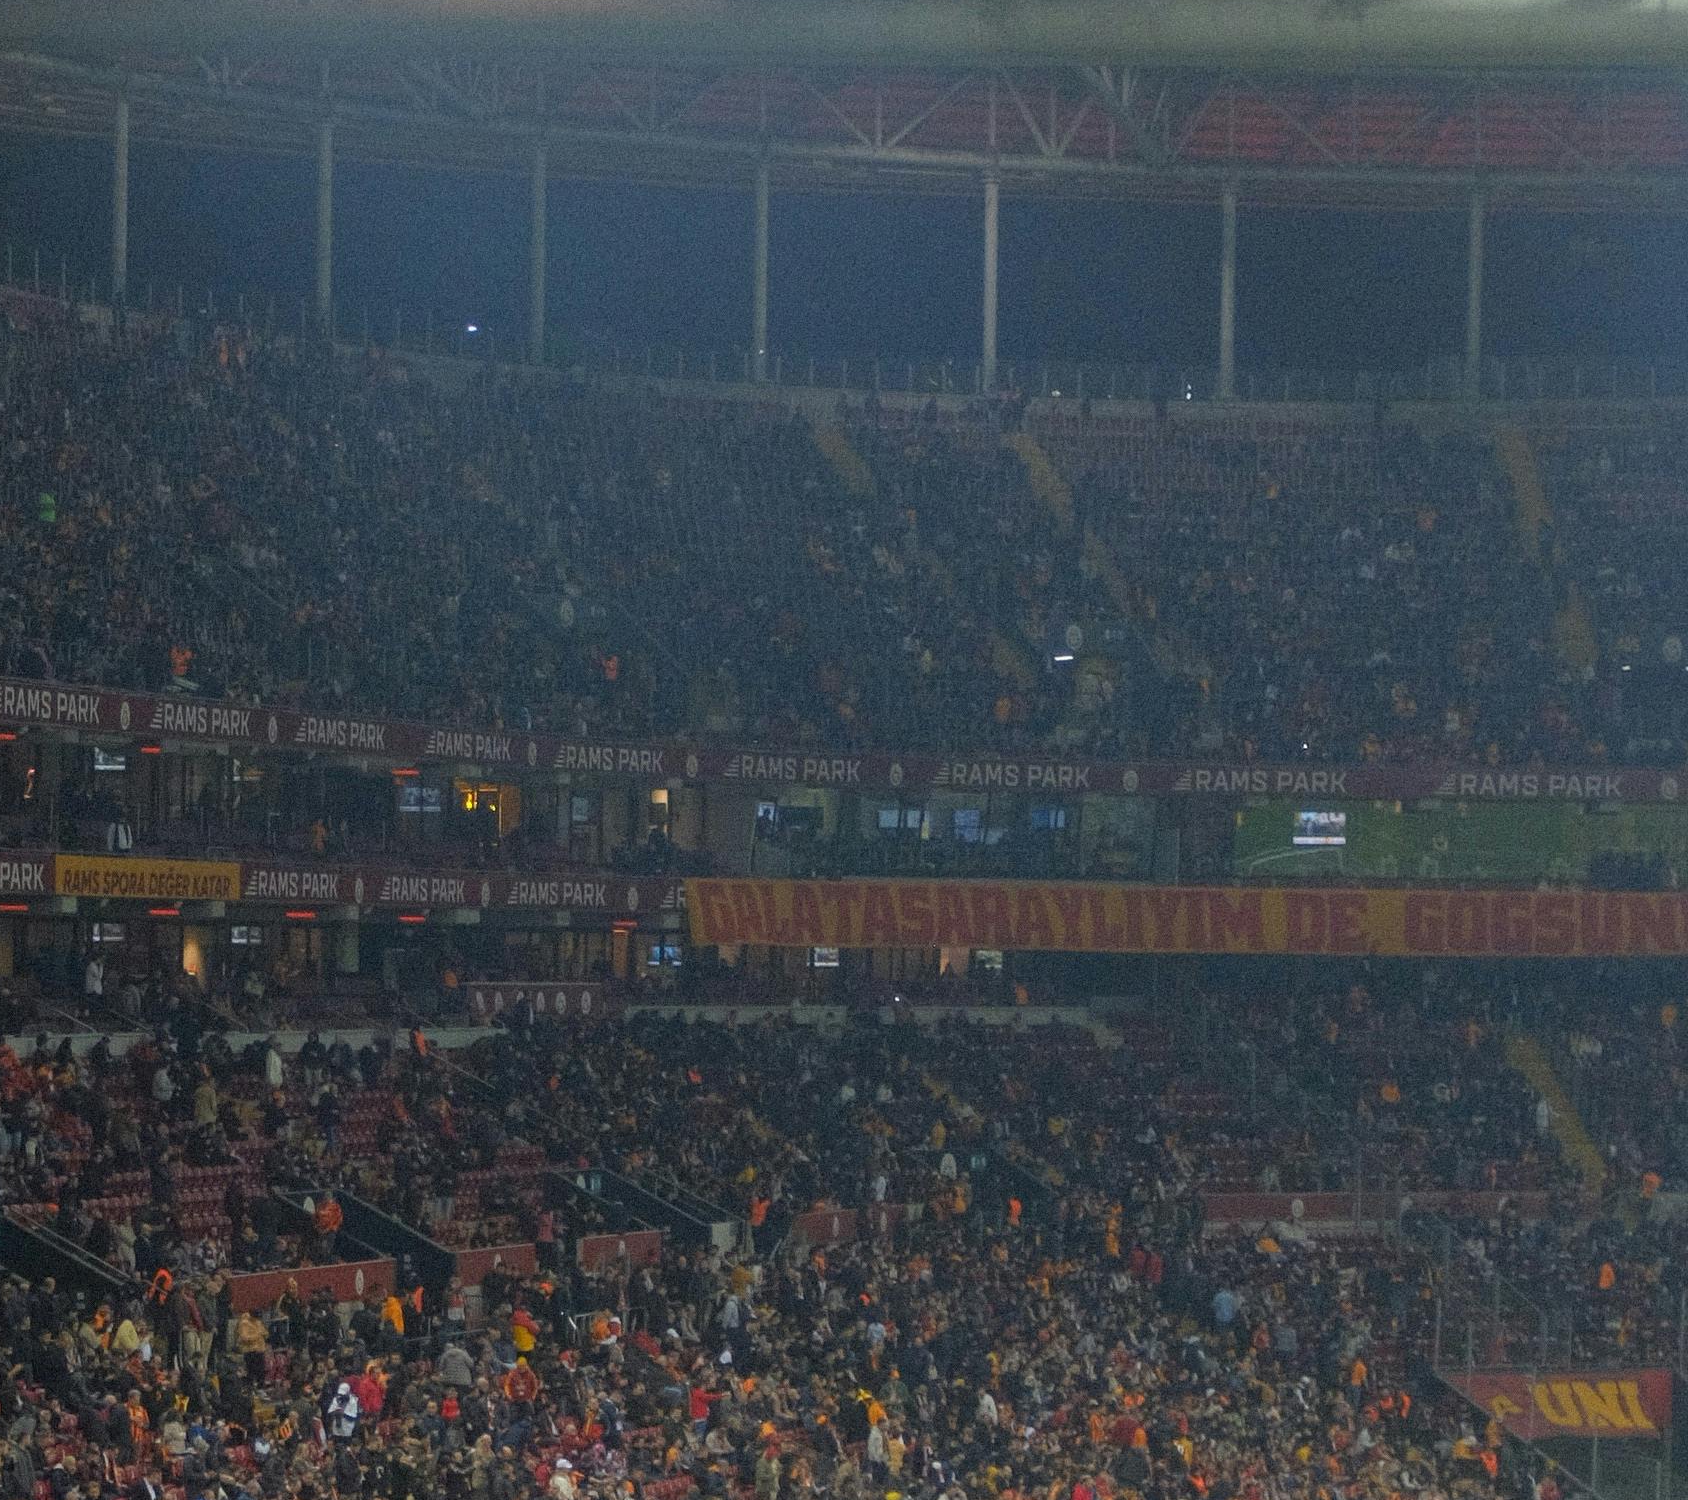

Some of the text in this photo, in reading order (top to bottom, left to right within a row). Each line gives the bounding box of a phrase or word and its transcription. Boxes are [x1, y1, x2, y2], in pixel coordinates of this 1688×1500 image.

[4, 686, 101, 724] RAMS PARK
[164, 702, 251, 737] RAMS PARK
[308, 716, 386, 750] RAMS PARK
[434, 730, 511, 761] RAMS PARK
[566, 744, 664, 773] RAMS PARK
[742, 754, 861, 783] RAMS PARK
[953, 762, 1090, 788] RAMS PARK
[1196, 769, 1347, 794] RAMS PARK
[1461, 772, 1623, 798] RAMS PARK
[0, 861, 45, 891] PARK
[63, 870, 99, 893] RAMS
[103, 871, 146, 896] SPORA
[194, 874, 231, 899] KATAR
[258, 870, 339, 898] RAMS PARK
[391, 875, 465, 903] RAMS PARK
[519, 880, 607, 906] RAMS PARK
